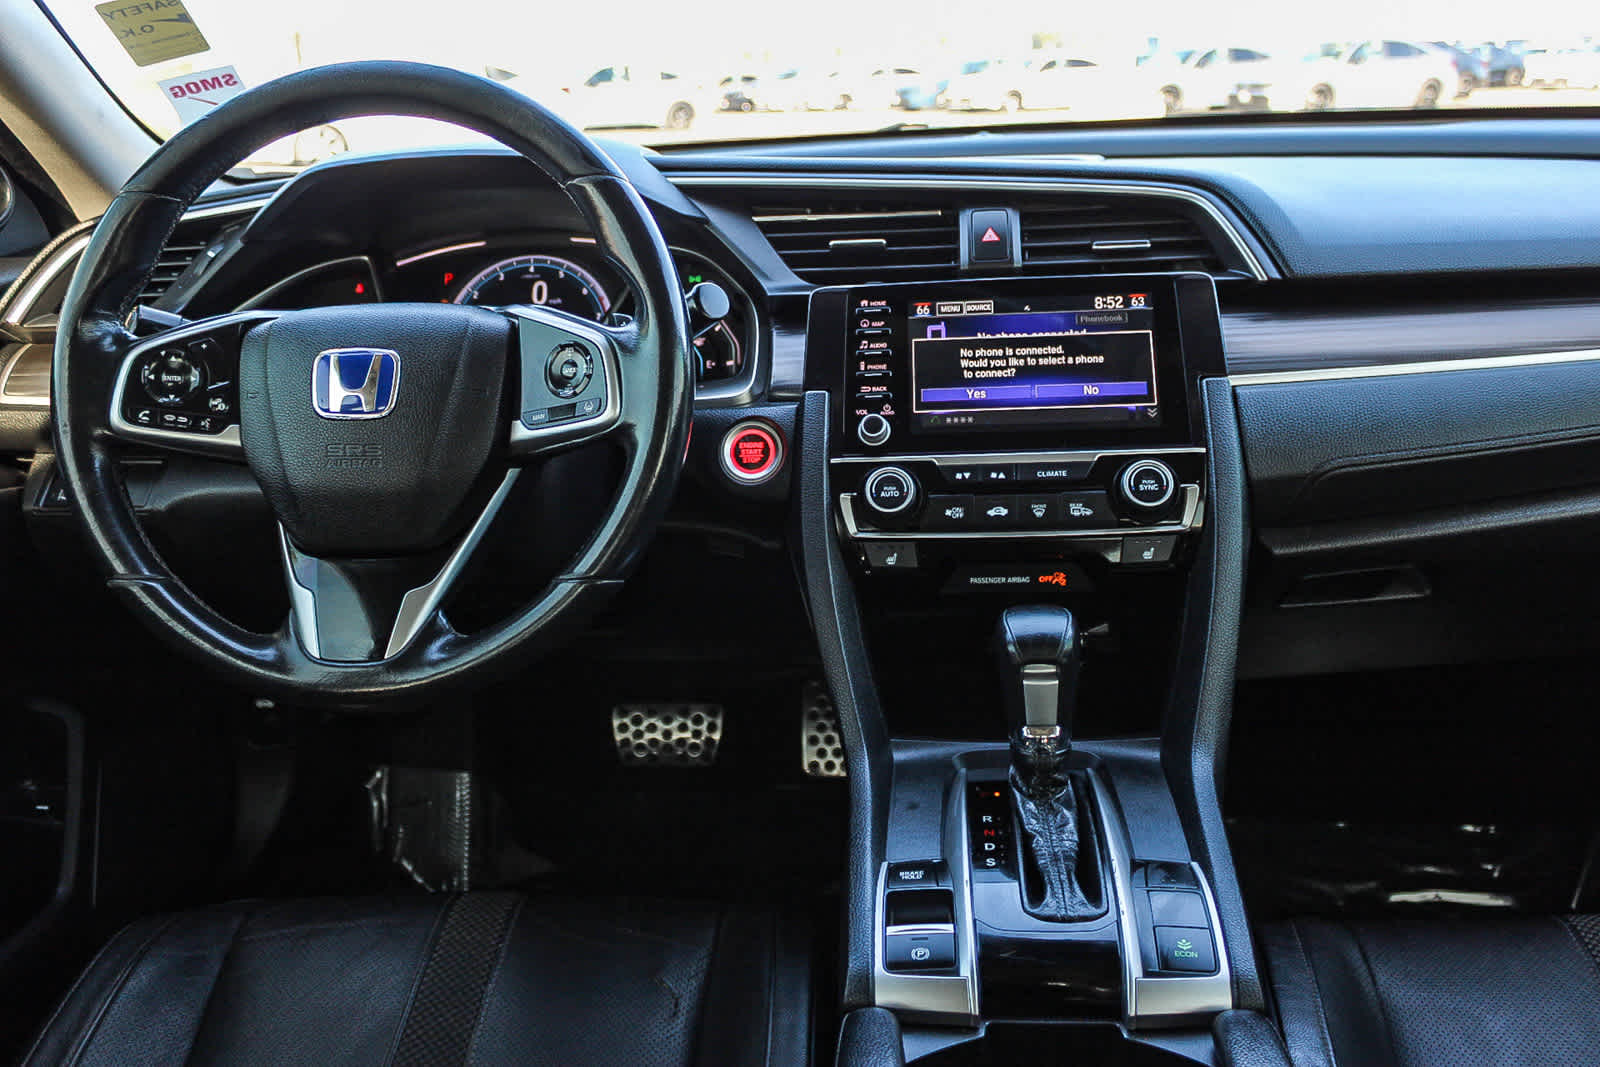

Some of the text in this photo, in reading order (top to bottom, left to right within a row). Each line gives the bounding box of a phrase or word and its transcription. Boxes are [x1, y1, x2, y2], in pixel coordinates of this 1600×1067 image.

[443, 272, 454, 285] P
[531, 280, 548, 304] 0
[1094, 296, 1125, 309] 8:52
[1131, 296, 1145, 306] 63
[916, 304, 931, 315] 66
[940, 304, 961, 313] MENU
[966, 303, 992, 312] SOURCE
[1080, 314, 1124, 323] Phonebook
[960, 345, 1065, 358] No phone is connected.
[960, 358, 989, 368] Would
[989, 358, 1007, 368] you
[1008, 356, 1026, 367] like
[1026, 357, 1037, 366] to
[1038, 355, 1066, 366] select
[1075, 354, 1105, 365] phone
[963, 368, 1017, 378] to connect?
[966, 389, 987, 399] Yes
[1083, 385, 1100, 395] No
[327, 443, 383, 457] SRS
[1037, 470, 1068, 478] CLIMATE
[1139, 484, 1159, 492] SYNC
[1038, 575, 1053, 583] OFF
[982, 815, 993, 823] R
[983, 829, 995, 837] N
[984, 843, 996, 851] D
[985, 858, 996, 867] S
[1174, 950, 1199, 958] ECON
